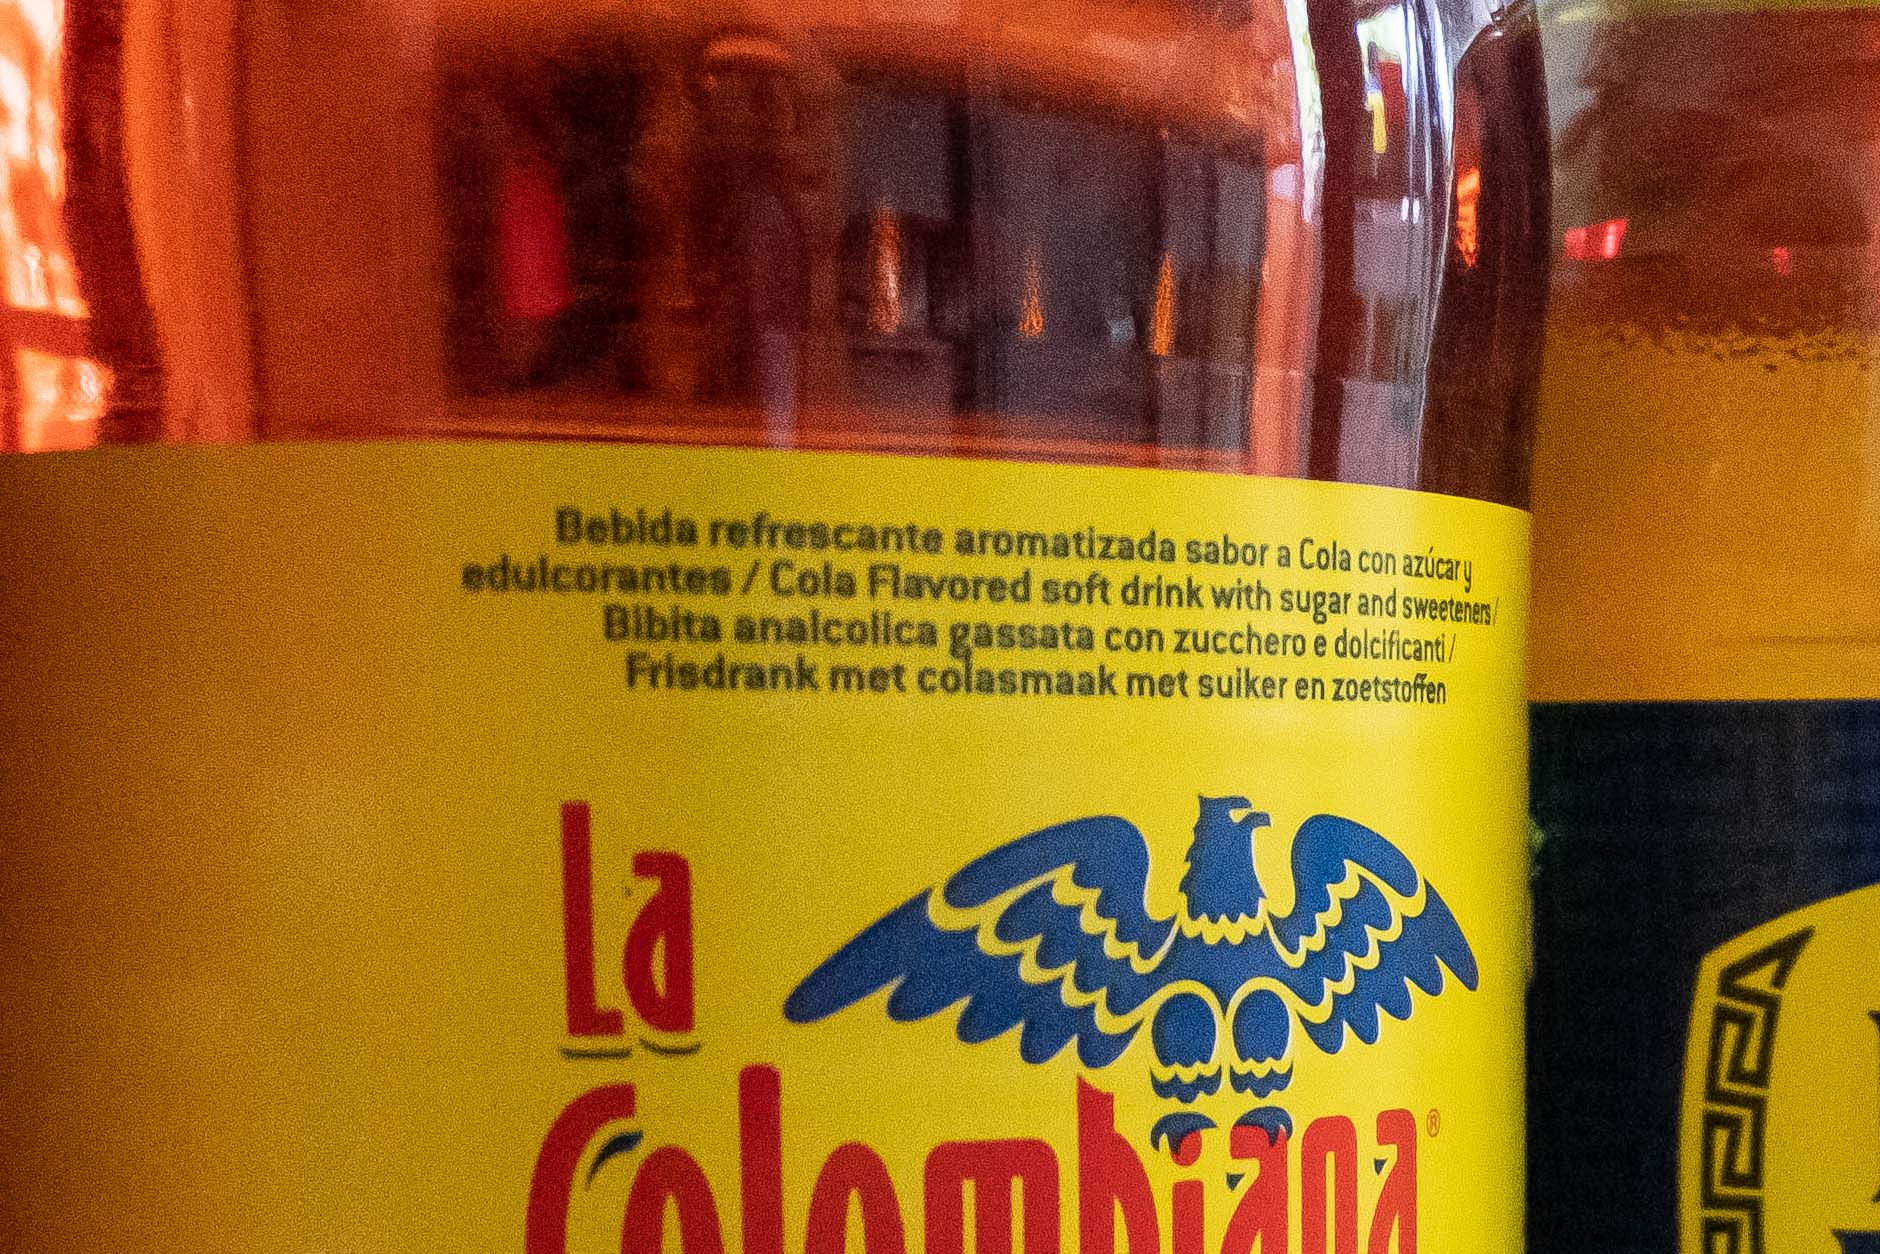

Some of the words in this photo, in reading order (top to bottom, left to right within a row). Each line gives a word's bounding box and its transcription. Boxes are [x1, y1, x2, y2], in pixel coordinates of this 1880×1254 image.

[554, 507, 699, 547] Bebida
[708, 511, 944, 554] refrescante
[954, 526, 1176, 562] aromatizada
[1185, 533, 1266, 568] sabor
[1276, 544, 1291, 568] a
[1298, 537, 1351, 573] Cola
[1357, 551, 1397, 577] con
[1402, 546, 1461, 582] azúcar
[1462, 558, 1472, 593] y
[461, 554, 731, 597] edulcorantes
[769, 560, 856, 600] Cola
[867, 563, 1032, 603] Flavored
[1041, 571, 1111, 606] soft
[1120, 574, 1204, 609] drink
[1210, 577, 1271, 612] with
[1279, 589, 1352, 625] sugar
[1357, 587, 1397, 619] and
[602, 603, 722, 644] Bibita
[733, 607, 938, 648] analcolica
[949, 621, 1096, 660] gassata
[1104, 625, 1164, 653] con
[1173, 624, 1306, 658] zucchero
[1313, 635, 1327, 658] e
[625, 651, 818, 693] Frisdrank
[828, 663, 906, 695] met
[916, 651, 1118, 696] colasmaak
[1126, 670, 1189, 700] met
[1198, 668, 1291, 702] suiker
[1294, 676, 1326, 702] en
[1331, 671, 1447, 706] zoetstoffen
[559, 800, 698, 1045] La
